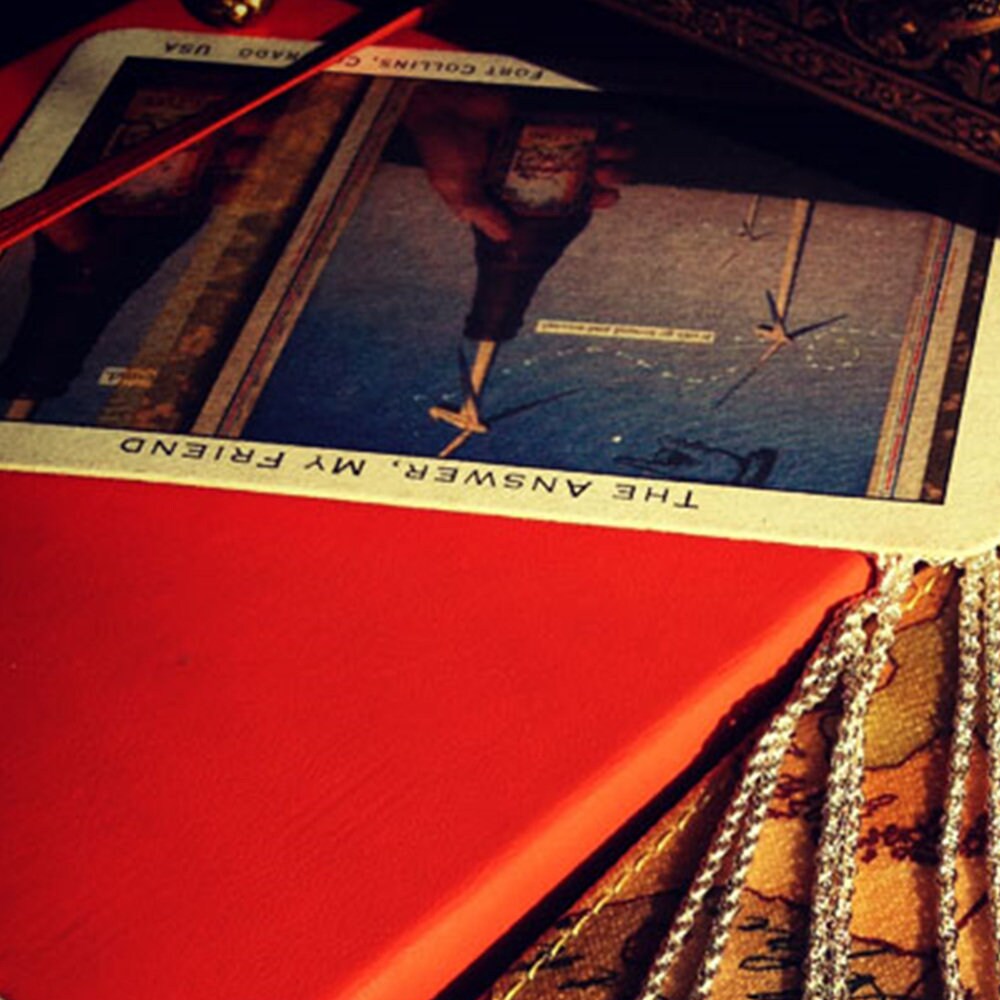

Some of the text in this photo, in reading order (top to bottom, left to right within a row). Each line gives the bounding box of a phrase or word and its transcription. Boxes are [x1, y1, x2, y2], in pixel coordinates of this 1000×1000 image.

[163, 42, 211, 57] USA
[372, 55, 476, 77] COLLINS,
[485, 66, 546, 82] FORT
[118, 435, 701, 510] THE ANSWER, MY FRIEND
